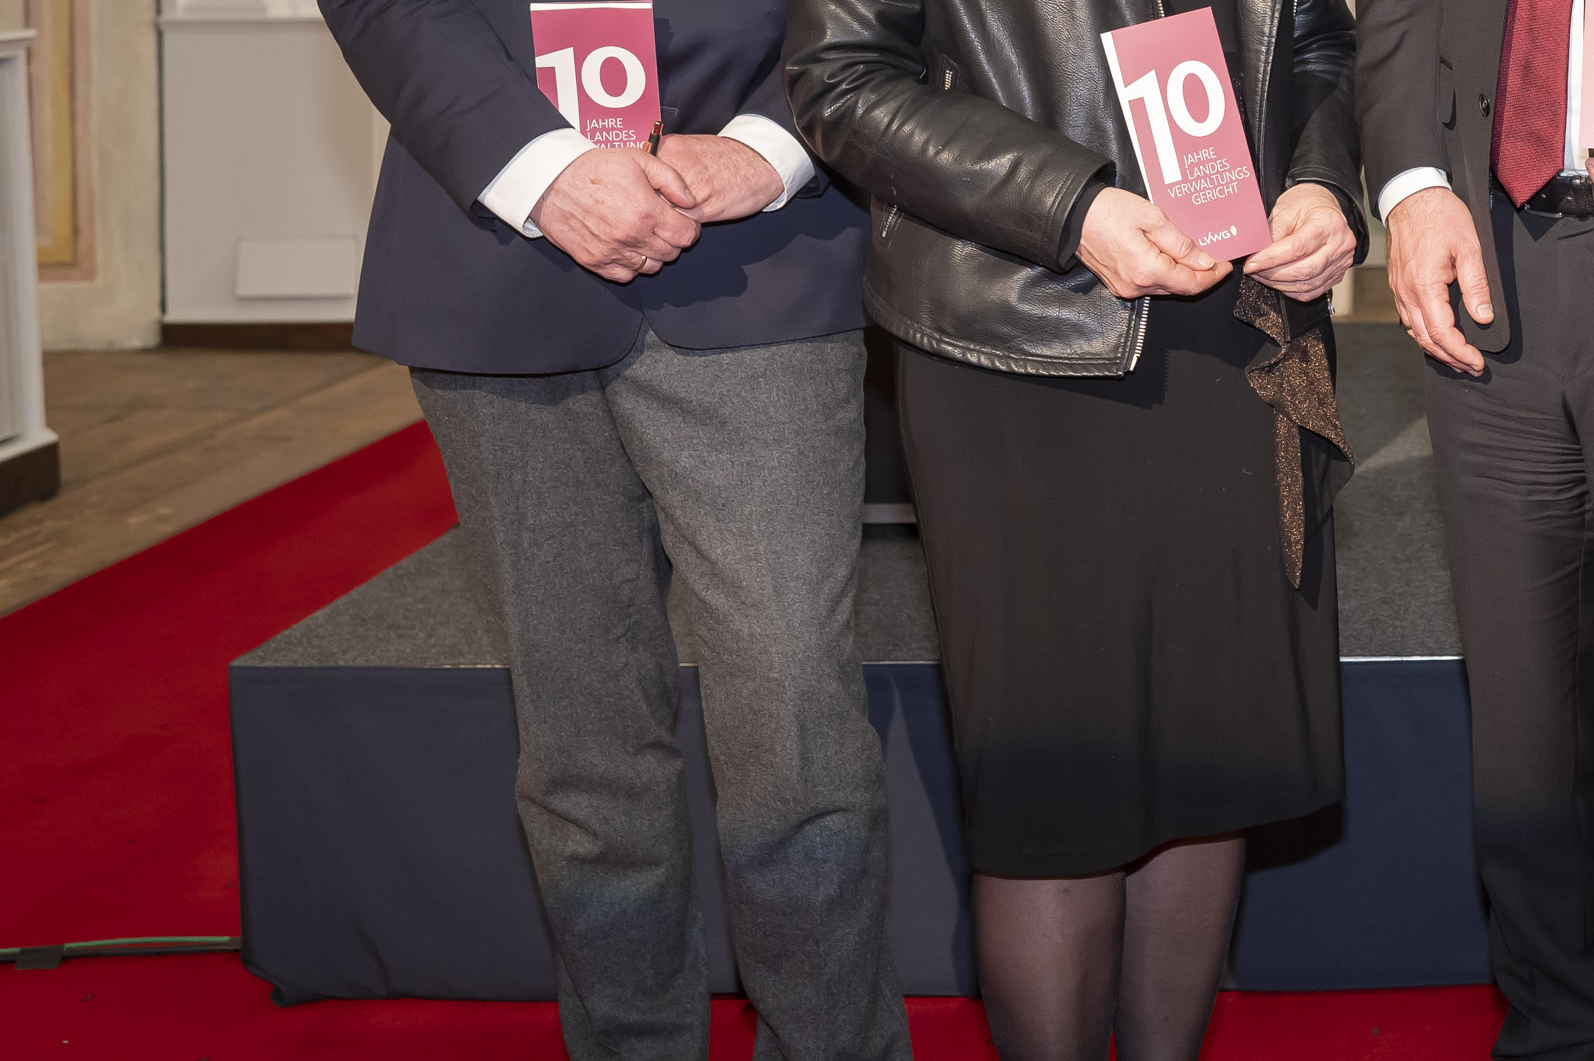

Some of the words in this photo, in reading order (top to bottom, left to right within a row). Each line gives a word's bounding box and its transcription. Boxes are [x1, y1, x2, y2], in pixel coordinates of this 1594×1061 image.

[535, 46, 646, 134] 10
[587, 118, 624, 131] JAHRE
[1123, 60, 1226, 185] 10
[588, 130, 636, 142] LANDES
[1183, 147, 1217, 168] JAHRE
[1187, 158, 1230, 179] LANDES
[1167, 166, 1250, 198] VERWALTUNGS
[1191, 182, 1239, 205] GERICHT
